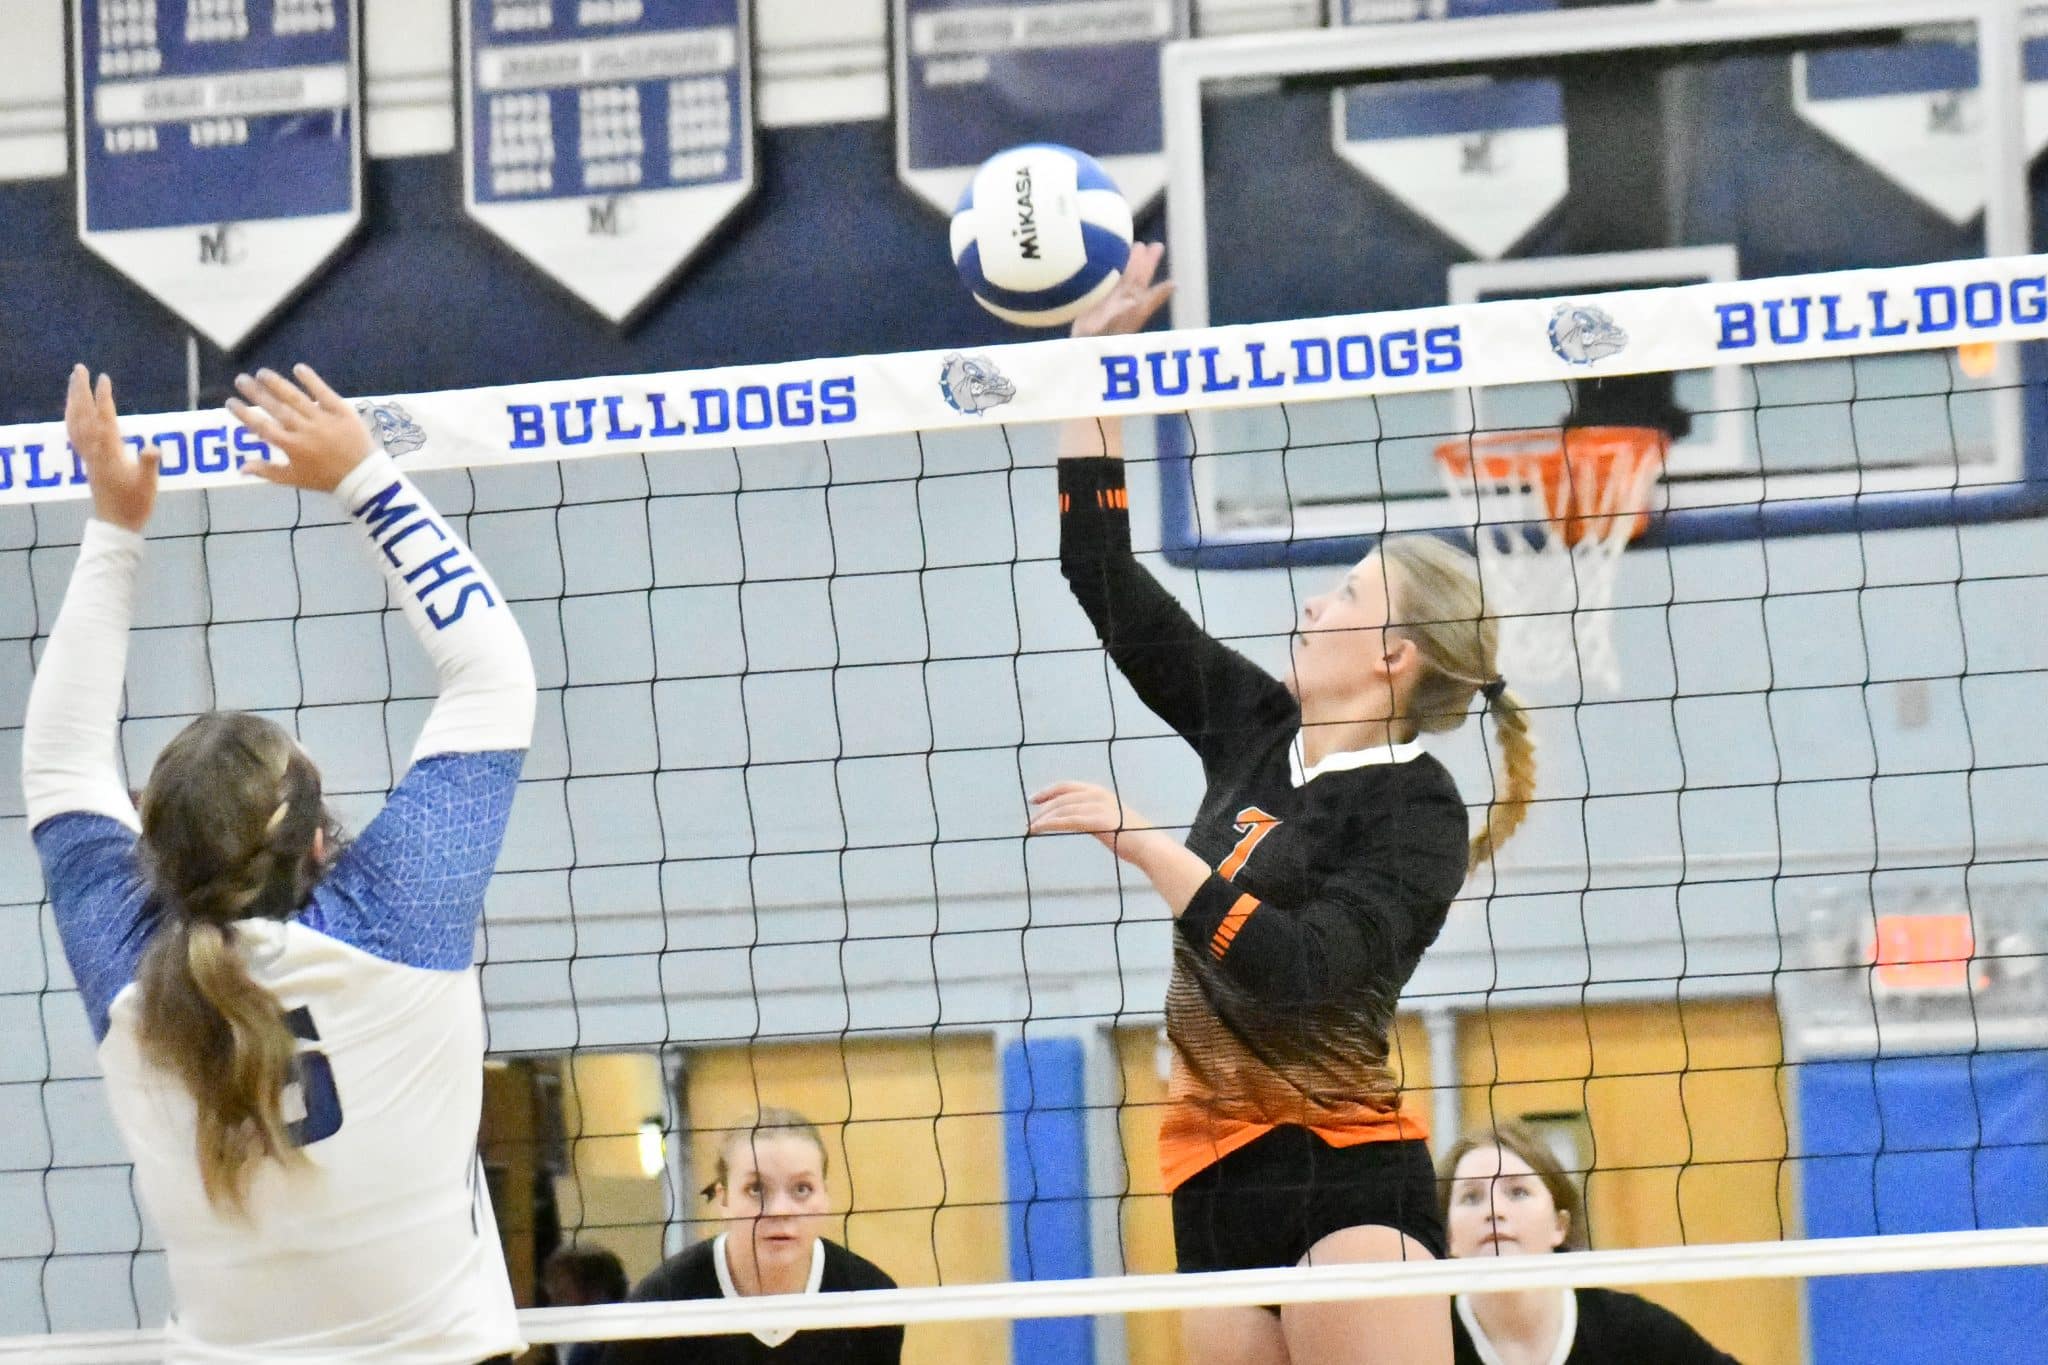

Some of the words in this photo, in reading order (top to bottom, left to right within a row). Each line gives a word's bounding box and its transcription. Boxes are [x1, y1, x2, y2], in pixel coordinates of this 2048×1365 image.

[1715, 275, 2048, 350] BULLDOG
[1100, 325, 1463, 401] BULLDOGS
[506, 376, 857, 449] BULLDOGS
[352, 480, 495, 631] MCHS
[1217, 806, 1284, 883] 7
